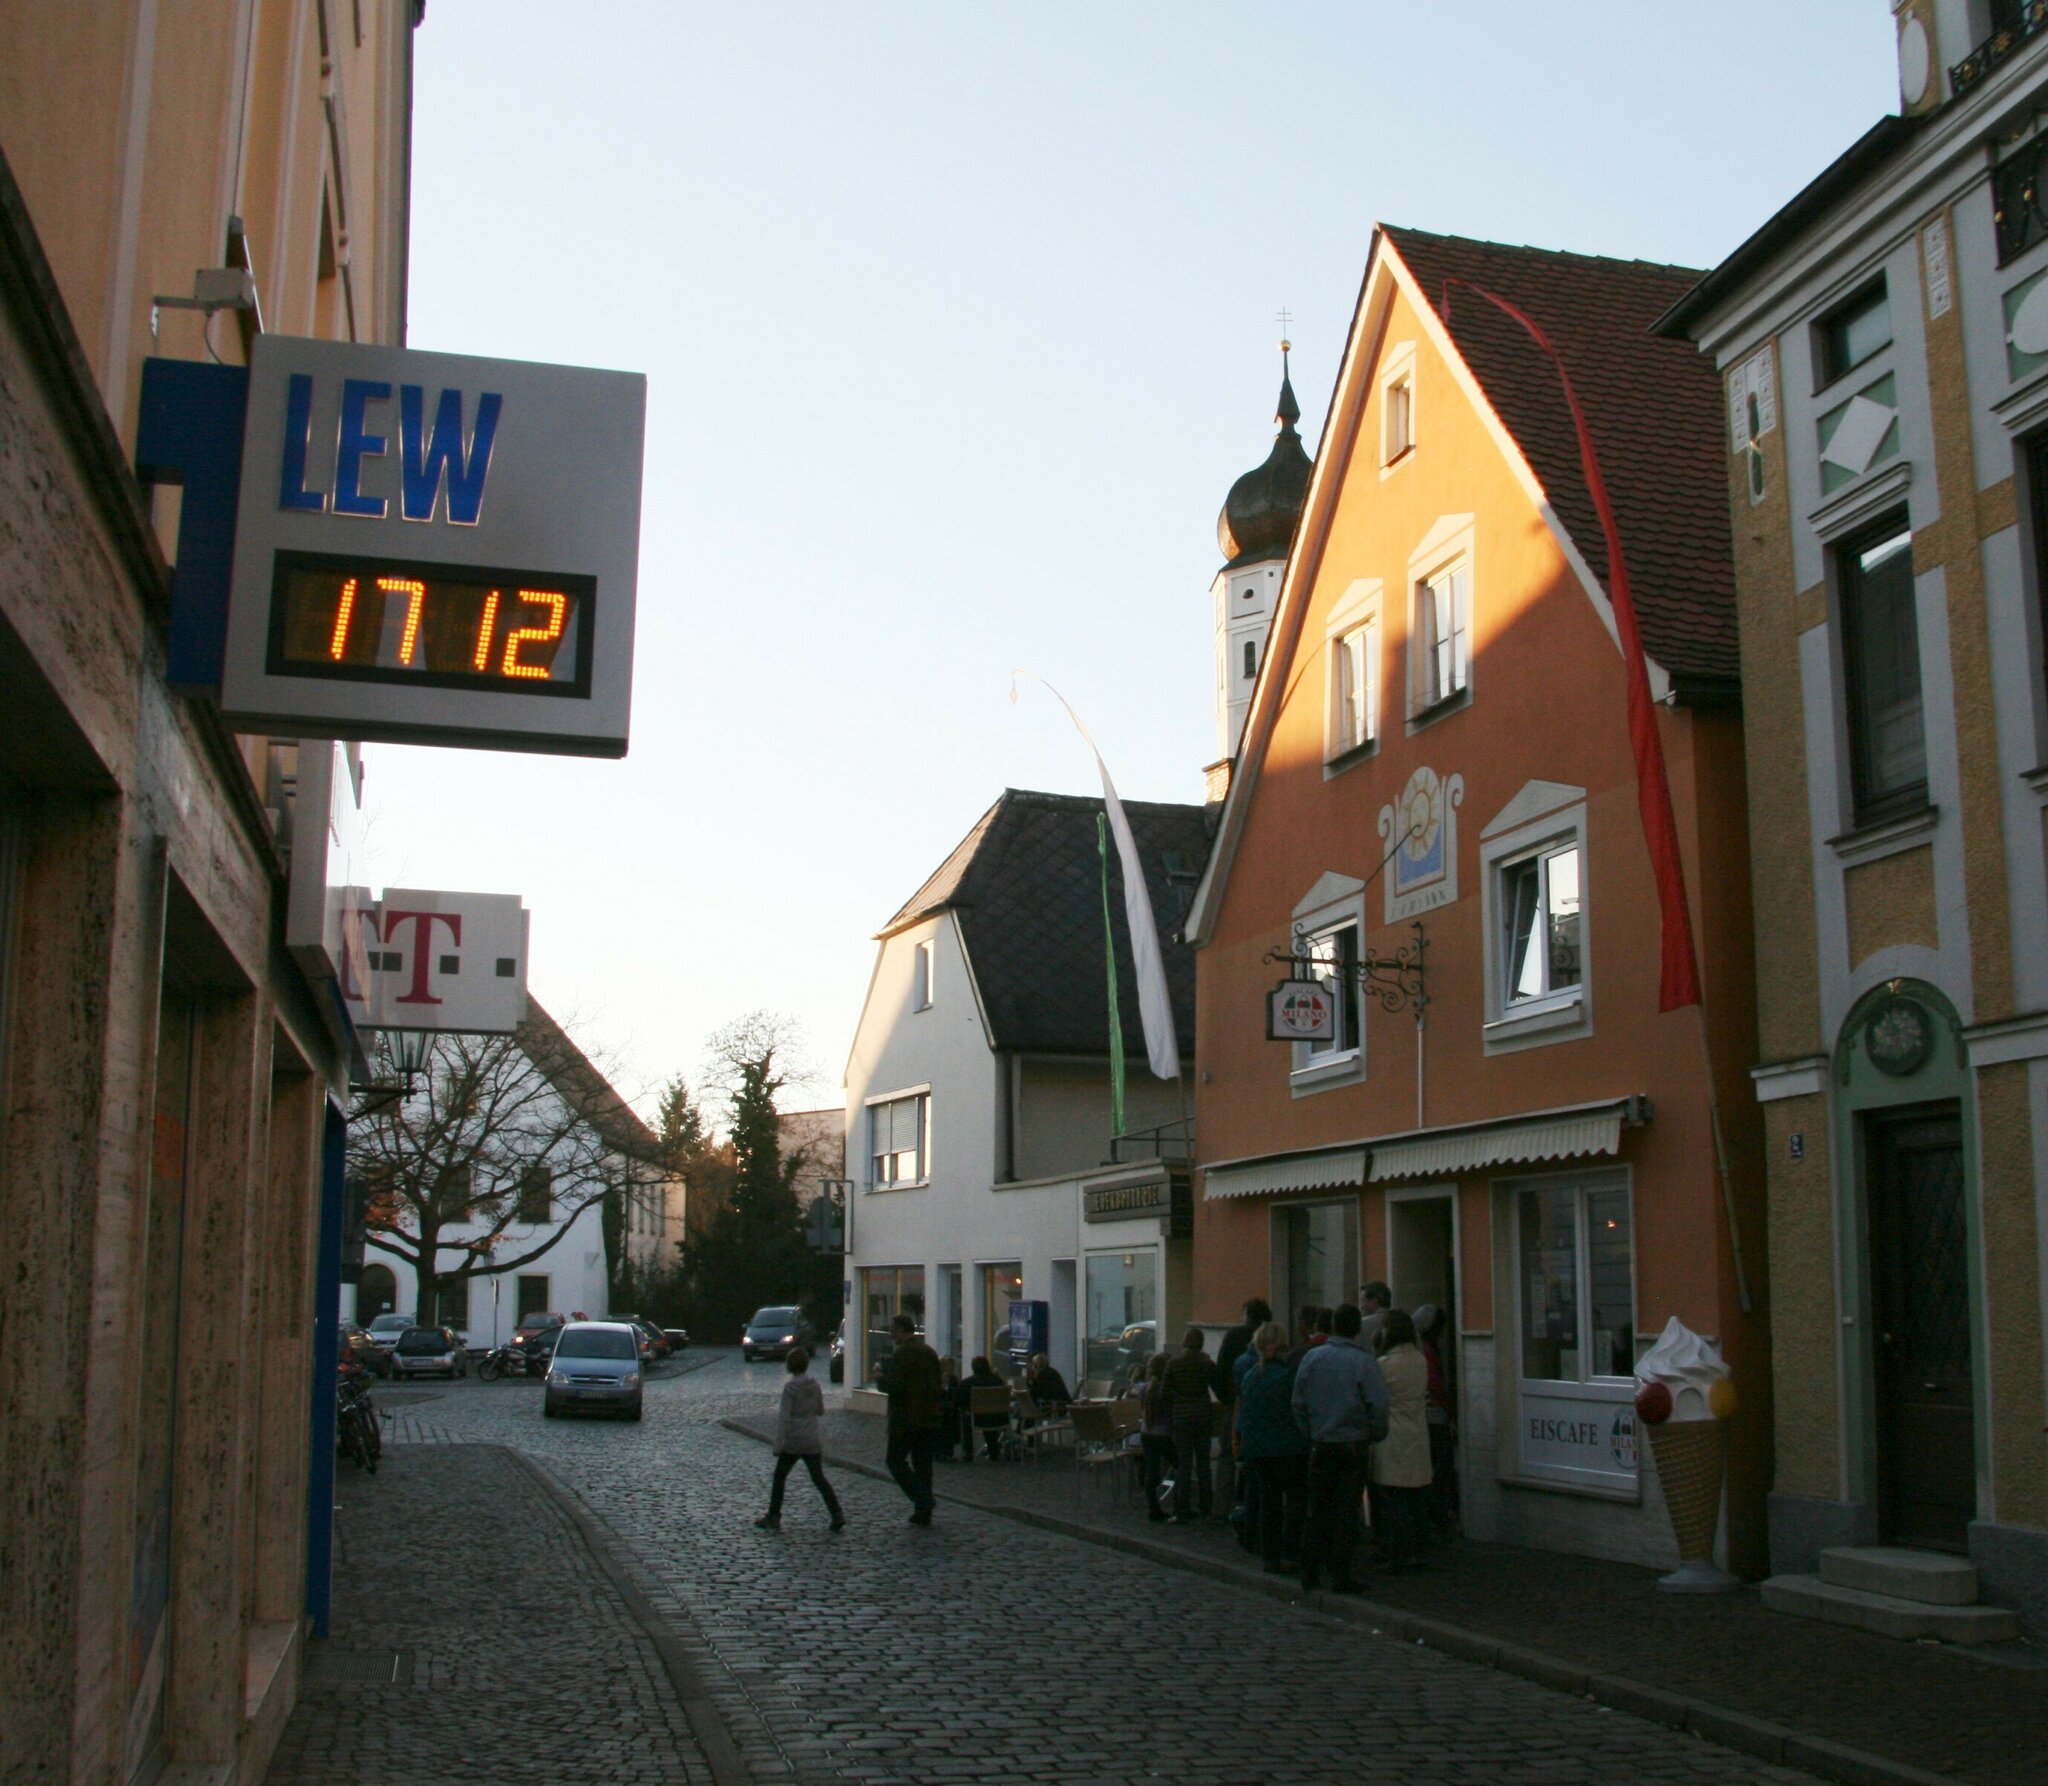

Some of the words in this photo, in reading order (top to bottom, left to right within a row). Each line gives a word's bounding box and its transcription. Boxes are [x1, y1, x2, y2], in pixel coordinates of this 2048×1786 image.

[278, 373, 503, 527] LEW
[1281, 1008, 1328, 1019] MILANO
[1530, 1417, 1598, 1445] EISCAFE
